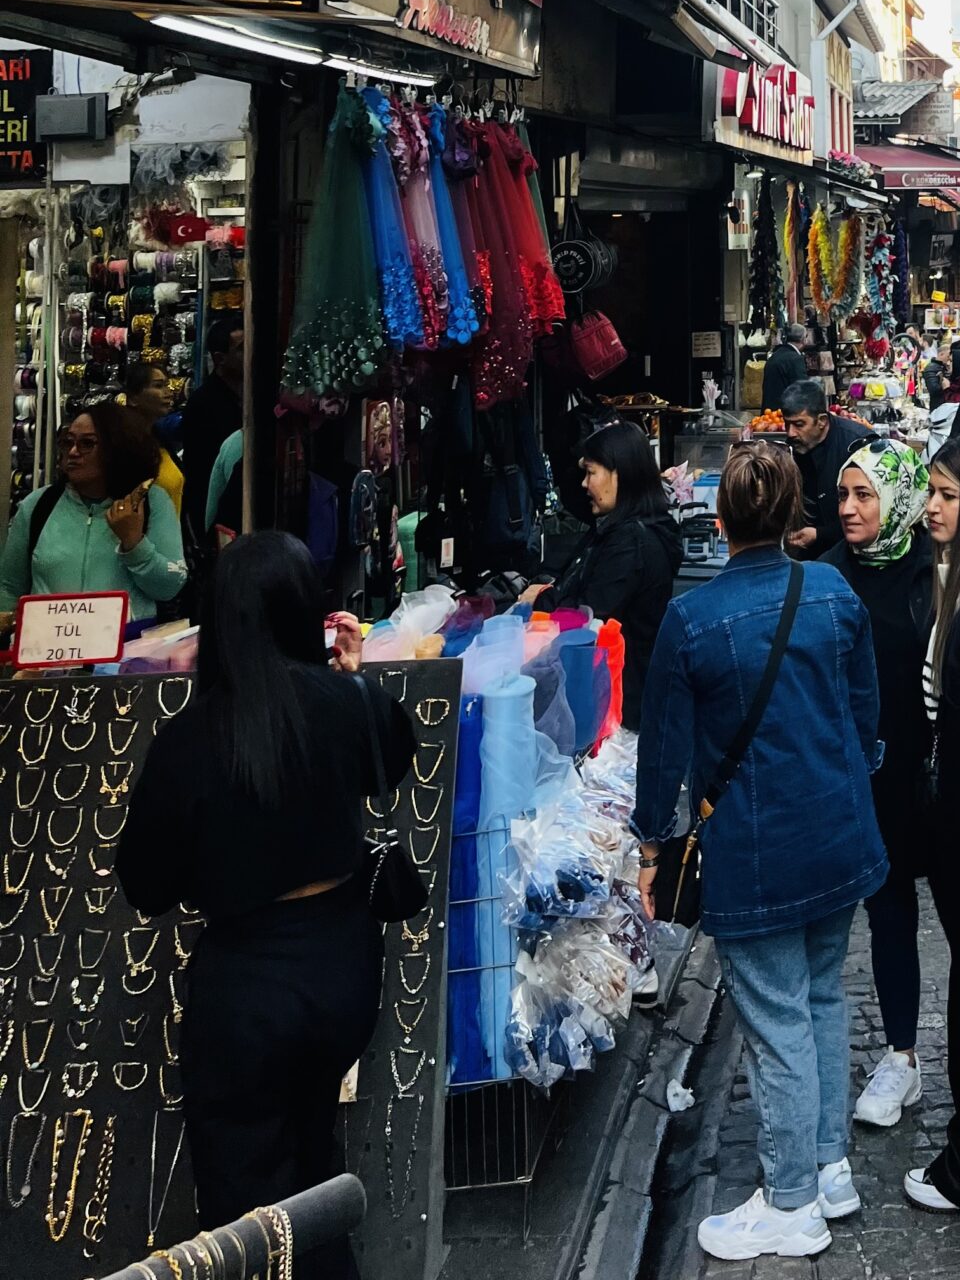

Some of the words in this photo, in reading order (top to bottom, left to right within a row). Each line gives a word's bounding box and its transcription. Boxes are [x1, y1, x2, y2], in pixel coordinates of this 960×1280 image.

[47, 602, 96, 615] HAYAL
[54, 622, 82, 637] TÜL
[46, 648, 64, 660] 20
[68, 647, 84, 659] TL
